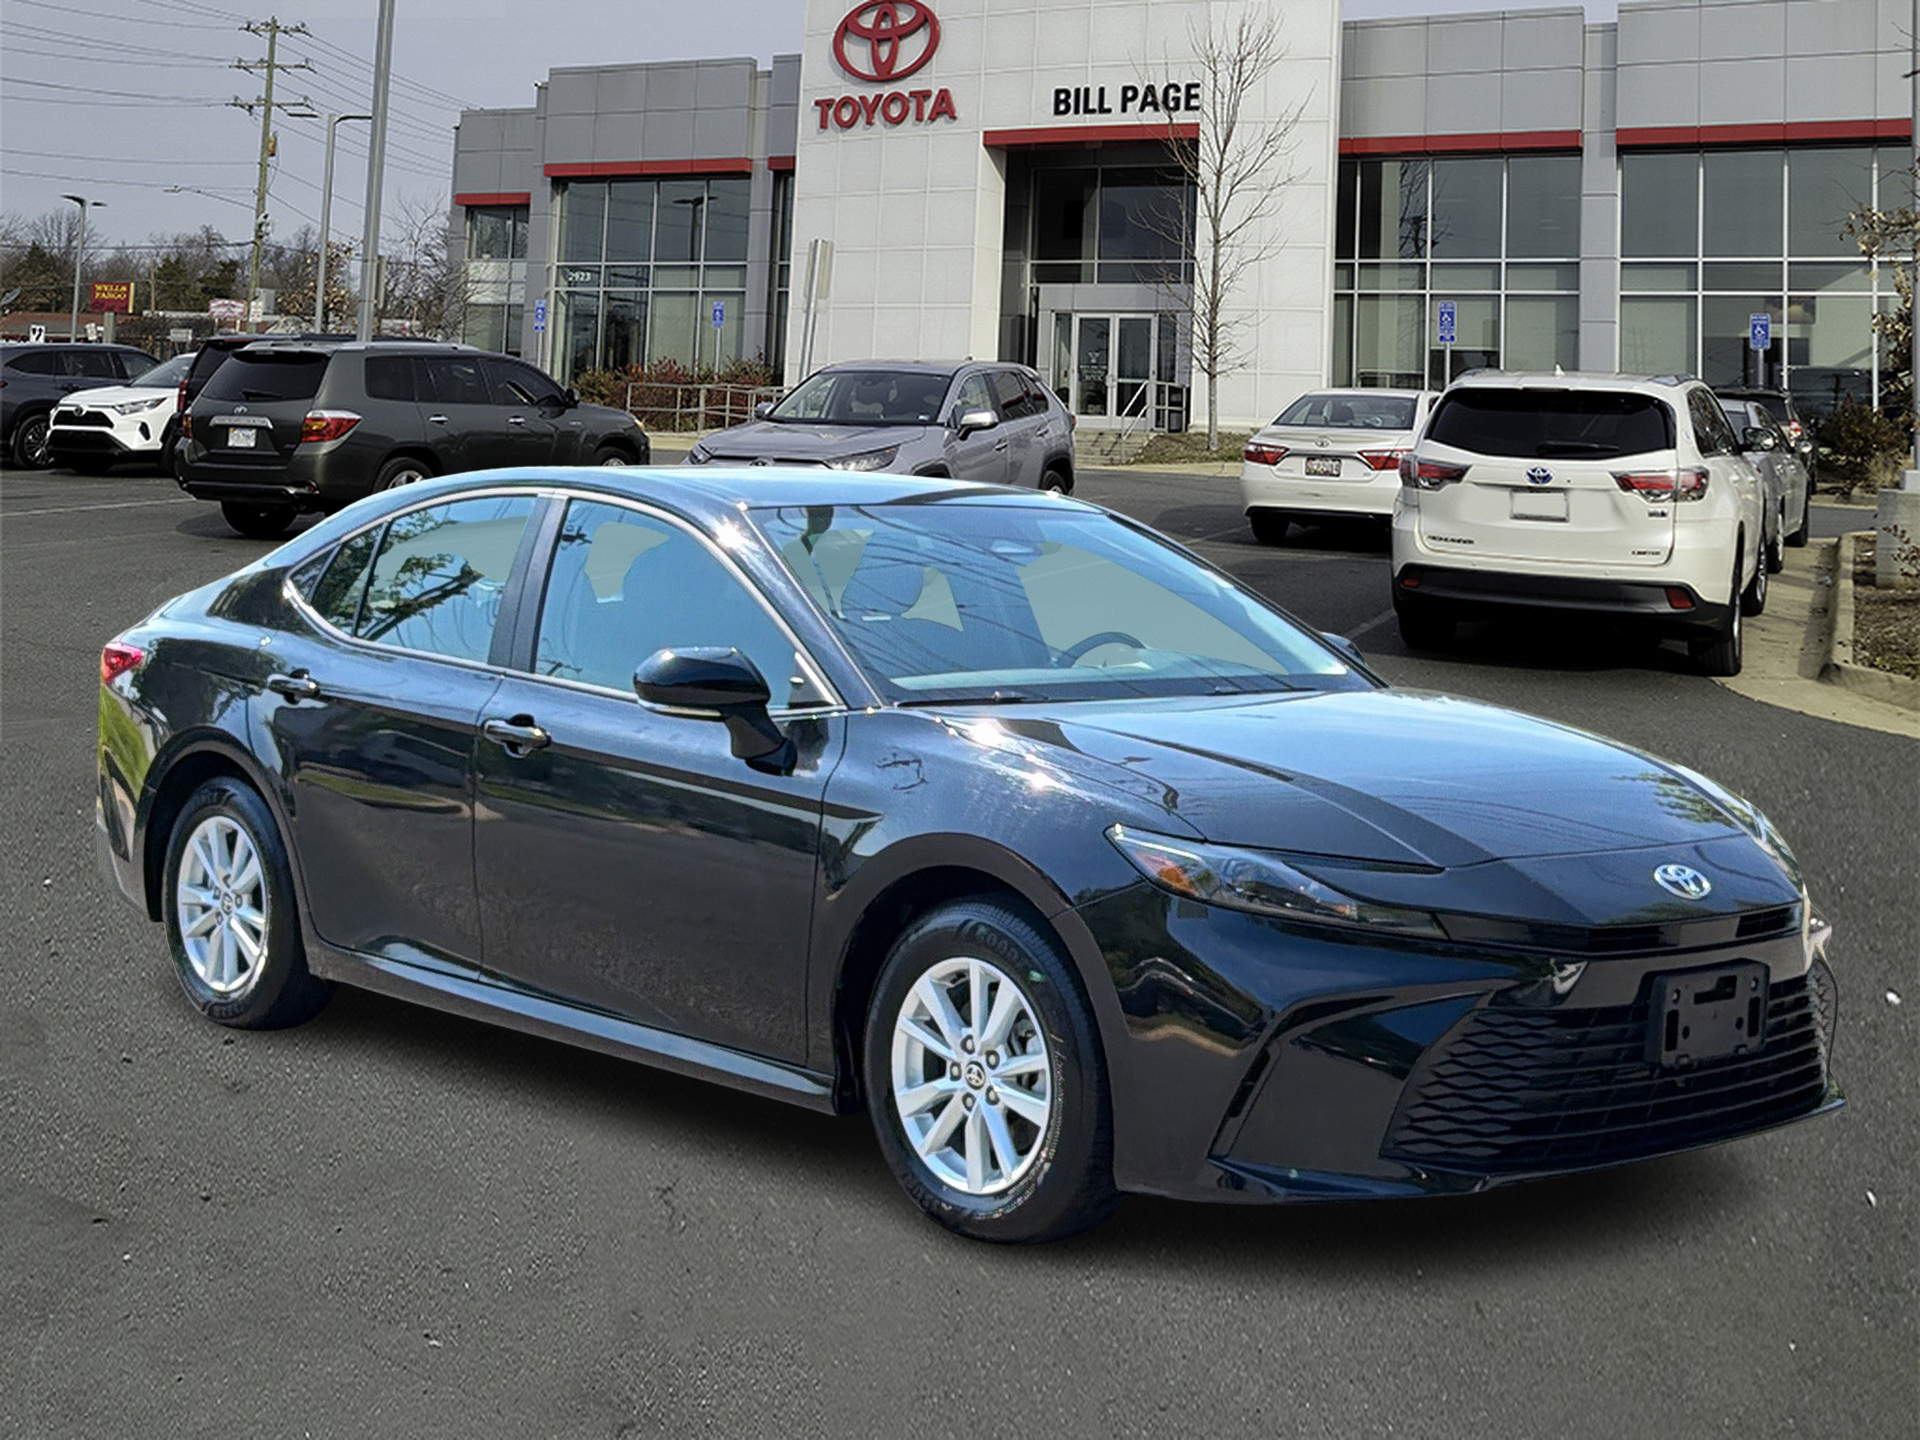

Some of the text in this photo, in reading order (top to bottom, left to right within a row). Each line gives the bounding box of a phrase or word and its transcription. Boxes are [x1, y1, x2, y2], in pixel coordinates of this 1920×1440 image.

[814, 88, 957, 129] TOYOTA
[1054, 83, 1201, 115] BILL PAGE
